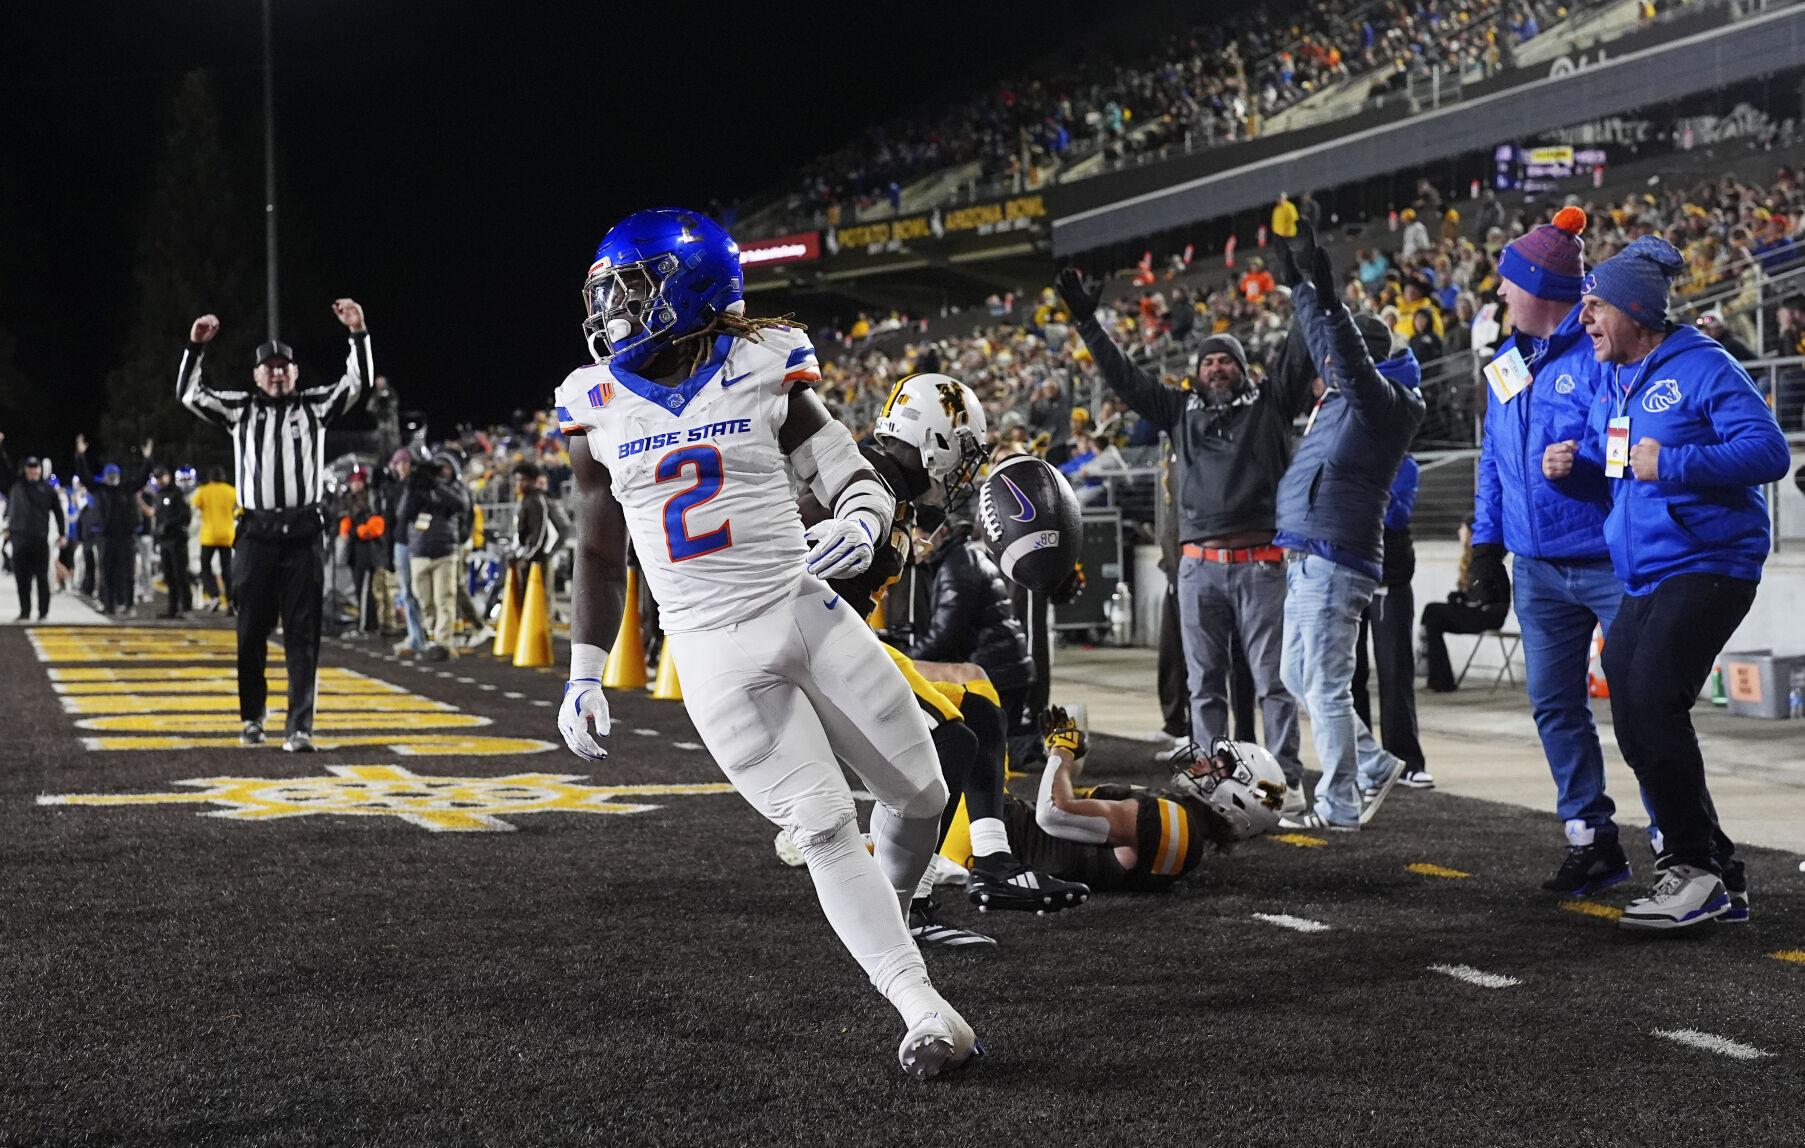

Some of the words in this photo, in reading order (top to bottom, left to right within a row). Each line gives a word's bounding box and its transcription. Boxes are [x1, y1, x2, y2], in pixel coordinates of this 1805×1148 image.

[618, 432, 681, 460] BOISE
[687, 418, 751, 443] STATE
[655, 444, 733, 564] 2
